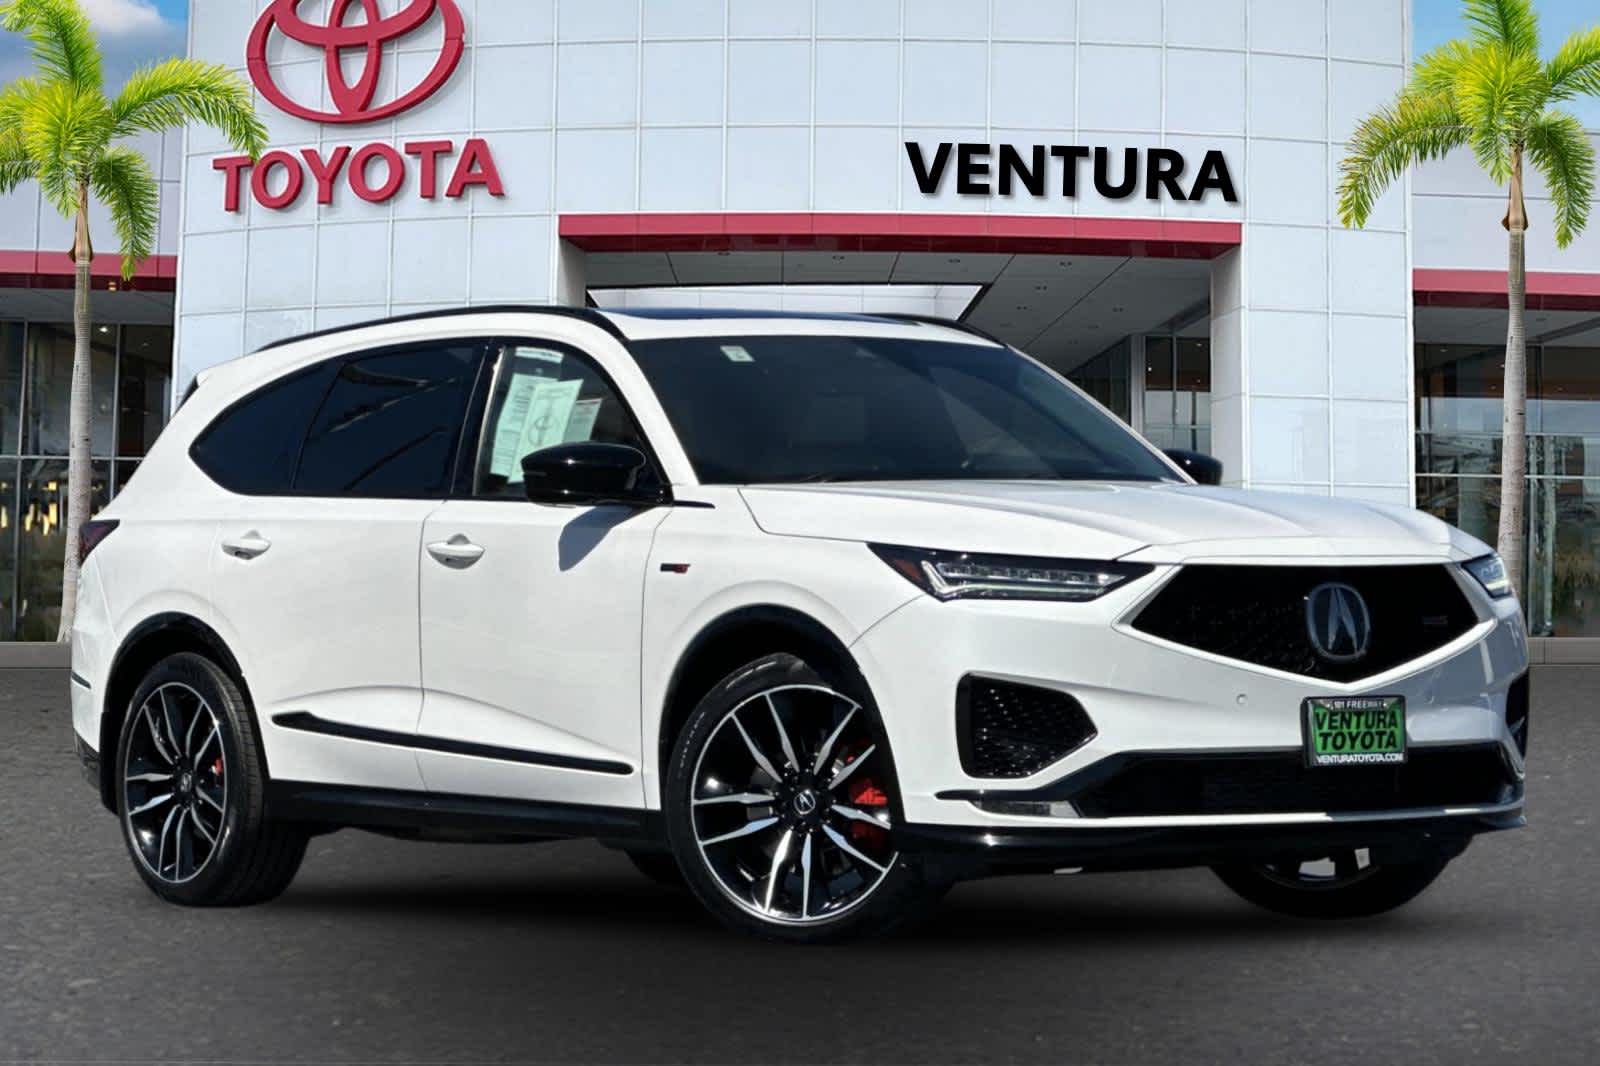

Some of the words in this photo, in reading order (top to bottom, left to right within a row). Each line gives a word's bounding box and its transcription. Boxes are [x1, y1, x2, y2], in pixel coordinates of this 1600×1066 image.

[212, 138, 505, 212] TOYOTA
[904, 141, 1239, 203] VENTURA
[1315, 710, 1398, 730] VENTURA
[1319, 730, 1398, 750] TOYOTA
[1316, 753, 1404, 763] VENTURATOYOTA.COM
